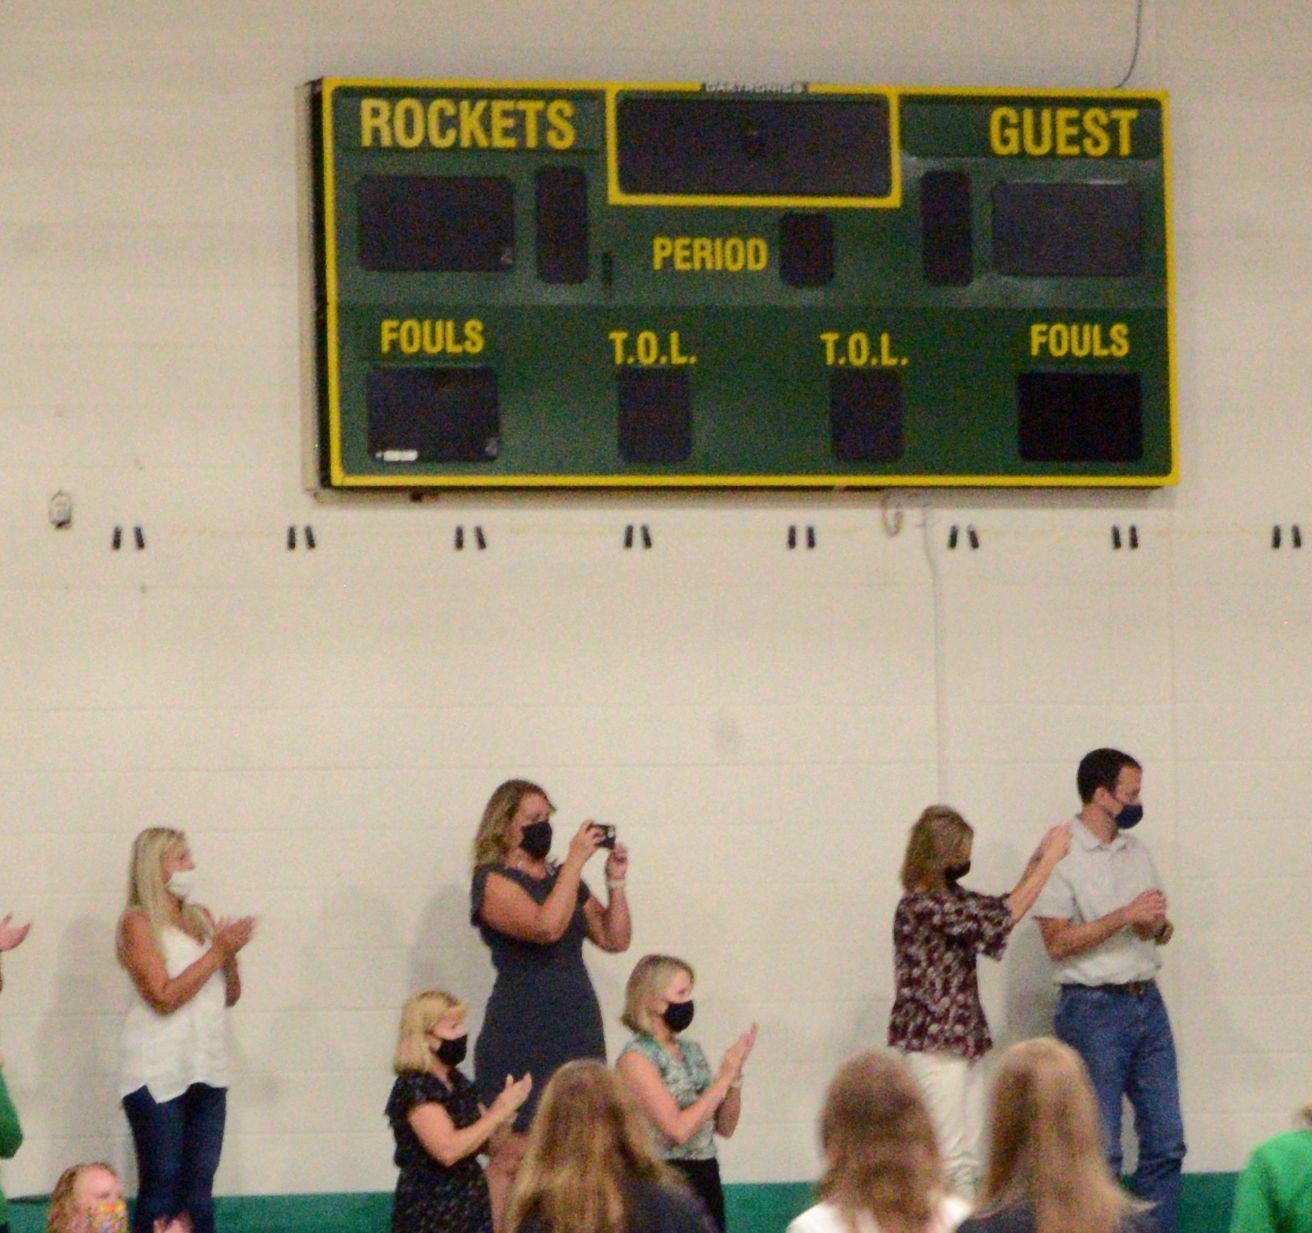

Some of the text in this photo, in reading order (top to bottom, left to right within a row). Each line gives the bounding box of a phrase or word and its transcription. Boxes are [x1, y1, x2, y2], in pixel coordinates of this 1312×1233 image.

[360, 97, 577, 150] ROCKETS
[990, 106, 1139, 158] GUEST
[652, 236, 770, 272] PERIOD
[381, 319, 486, 355] FOULS
[608, 330, 698, 366] T.O.L.
[820, 331, 910, 367] T.O.L.
[1030, 322, 1130, 358] FOULS
